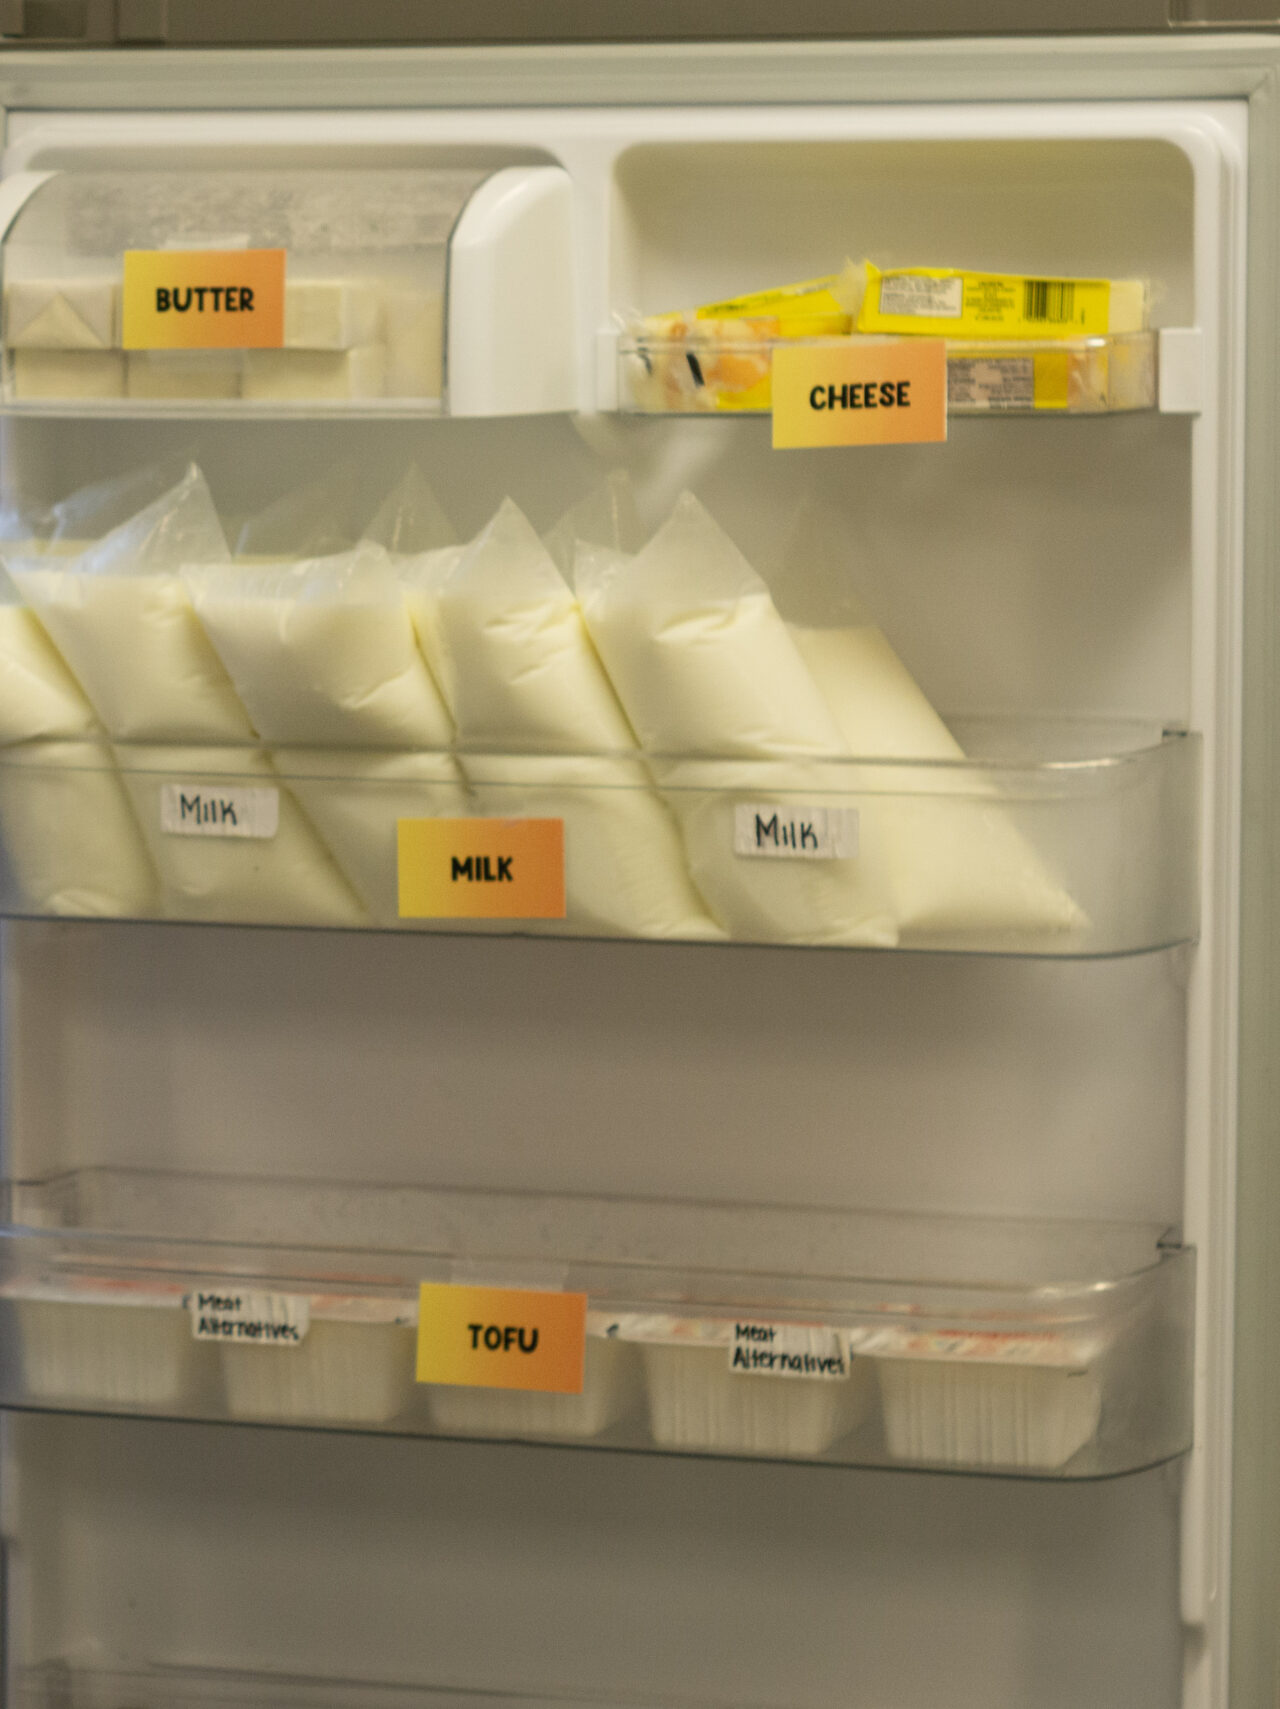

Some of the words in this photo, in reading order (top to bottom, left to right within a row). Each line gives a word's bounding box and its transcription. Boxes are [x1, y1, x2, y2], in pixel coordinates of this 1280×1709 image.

[155, 286, 255, 313] BUTTER
[809, 380, 911, 411] CHEESE
[179, 793, 238, 826] Milk
[755, 813, 819, 849] Milk
[451, 856, 514, 882] MILK
[198, 1293, 242, 1311] Meat
[198, 1317, 299, 1341] Alternatives
[467, 1324, 539, 1354] TOFU
[735, 1323, 777, 1342] Meat
[733, 1346, 846, 1375] Alternatives
